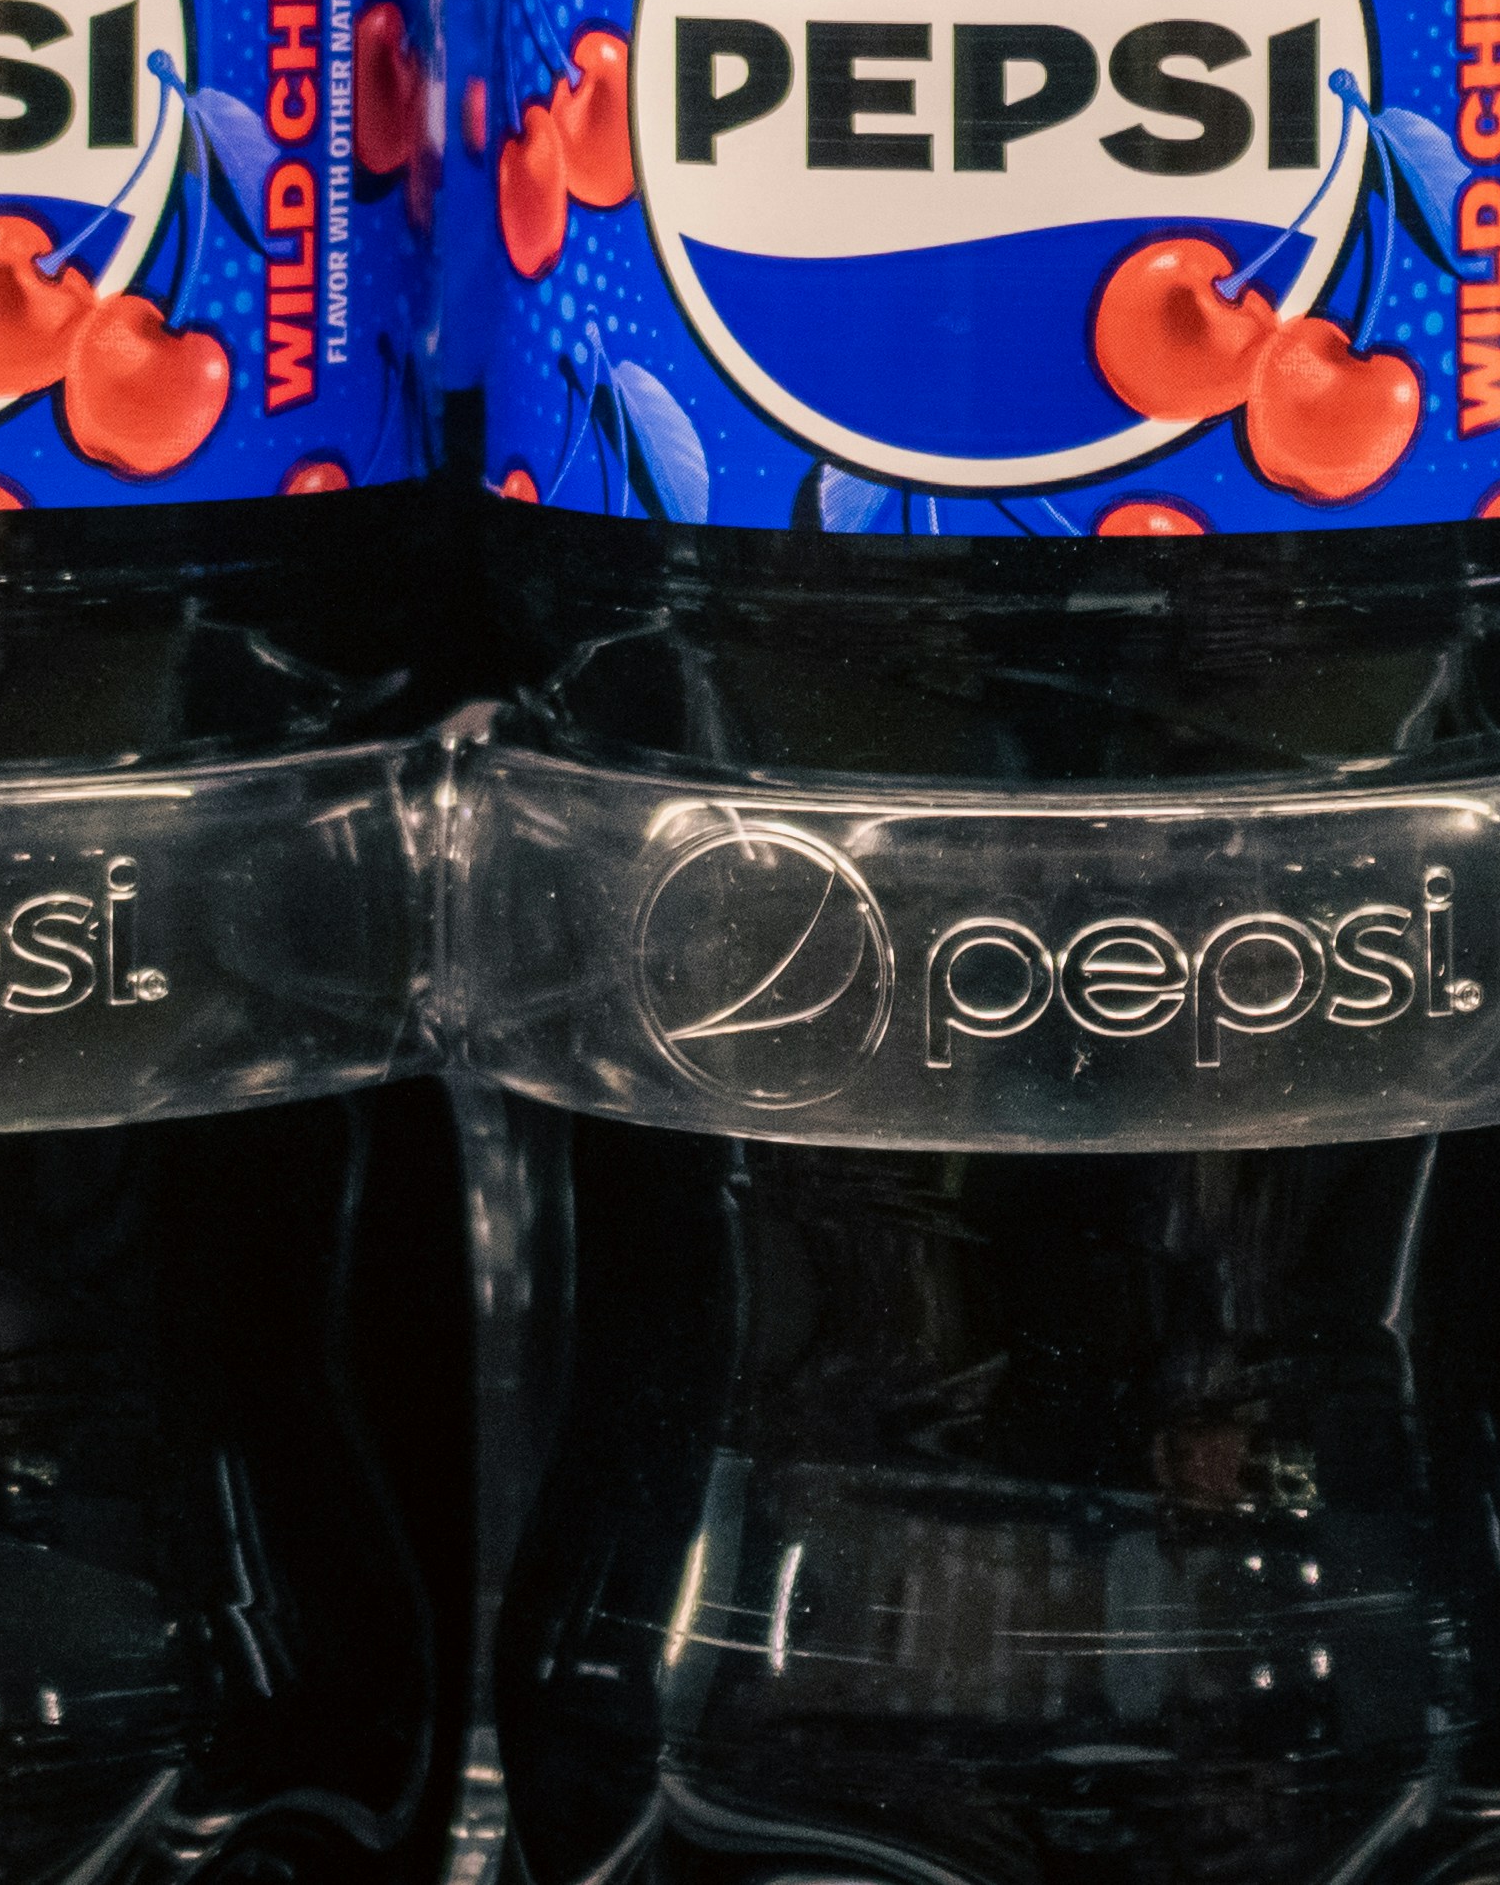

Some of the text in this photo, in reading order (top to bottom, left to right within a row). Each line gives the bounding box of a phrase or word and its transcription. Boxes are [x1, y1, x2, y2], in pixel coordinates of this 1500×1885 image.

[328, 59, 352, 158] OTHER
[674, 16, 1322, 175] PEPSI
[328, 164, 350, 244] WITH
[268, 161, 315, 409] WILD
[327, 251, 348, 364] FLAVOR
[925, 865, 1458, 1070] pepsi
